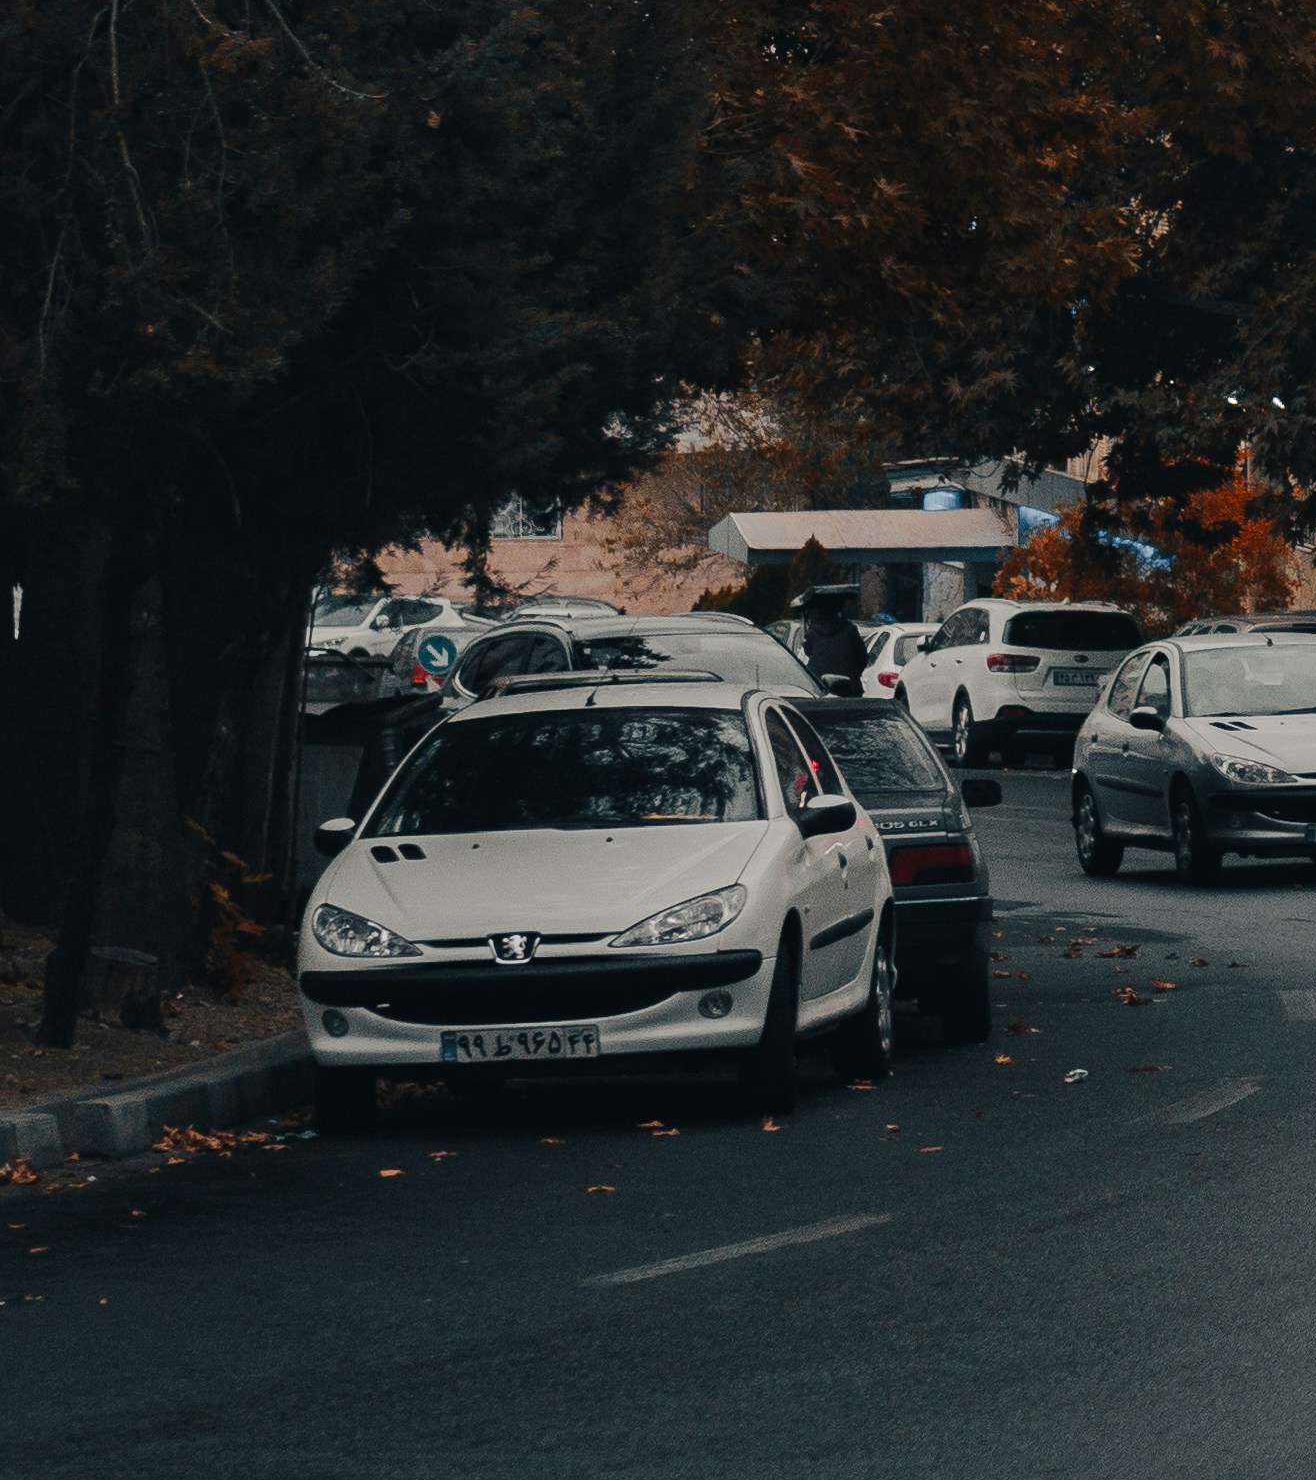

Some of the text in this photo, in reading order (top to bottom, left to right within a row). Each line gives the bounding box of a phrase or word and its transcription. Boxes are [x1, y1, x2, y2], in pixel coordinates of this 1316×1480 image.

[876, 819, 939, 829] 05 GLX
[458, 1031, 595, 1059] ۹۹ ط ۹۶۵ ۴۴
